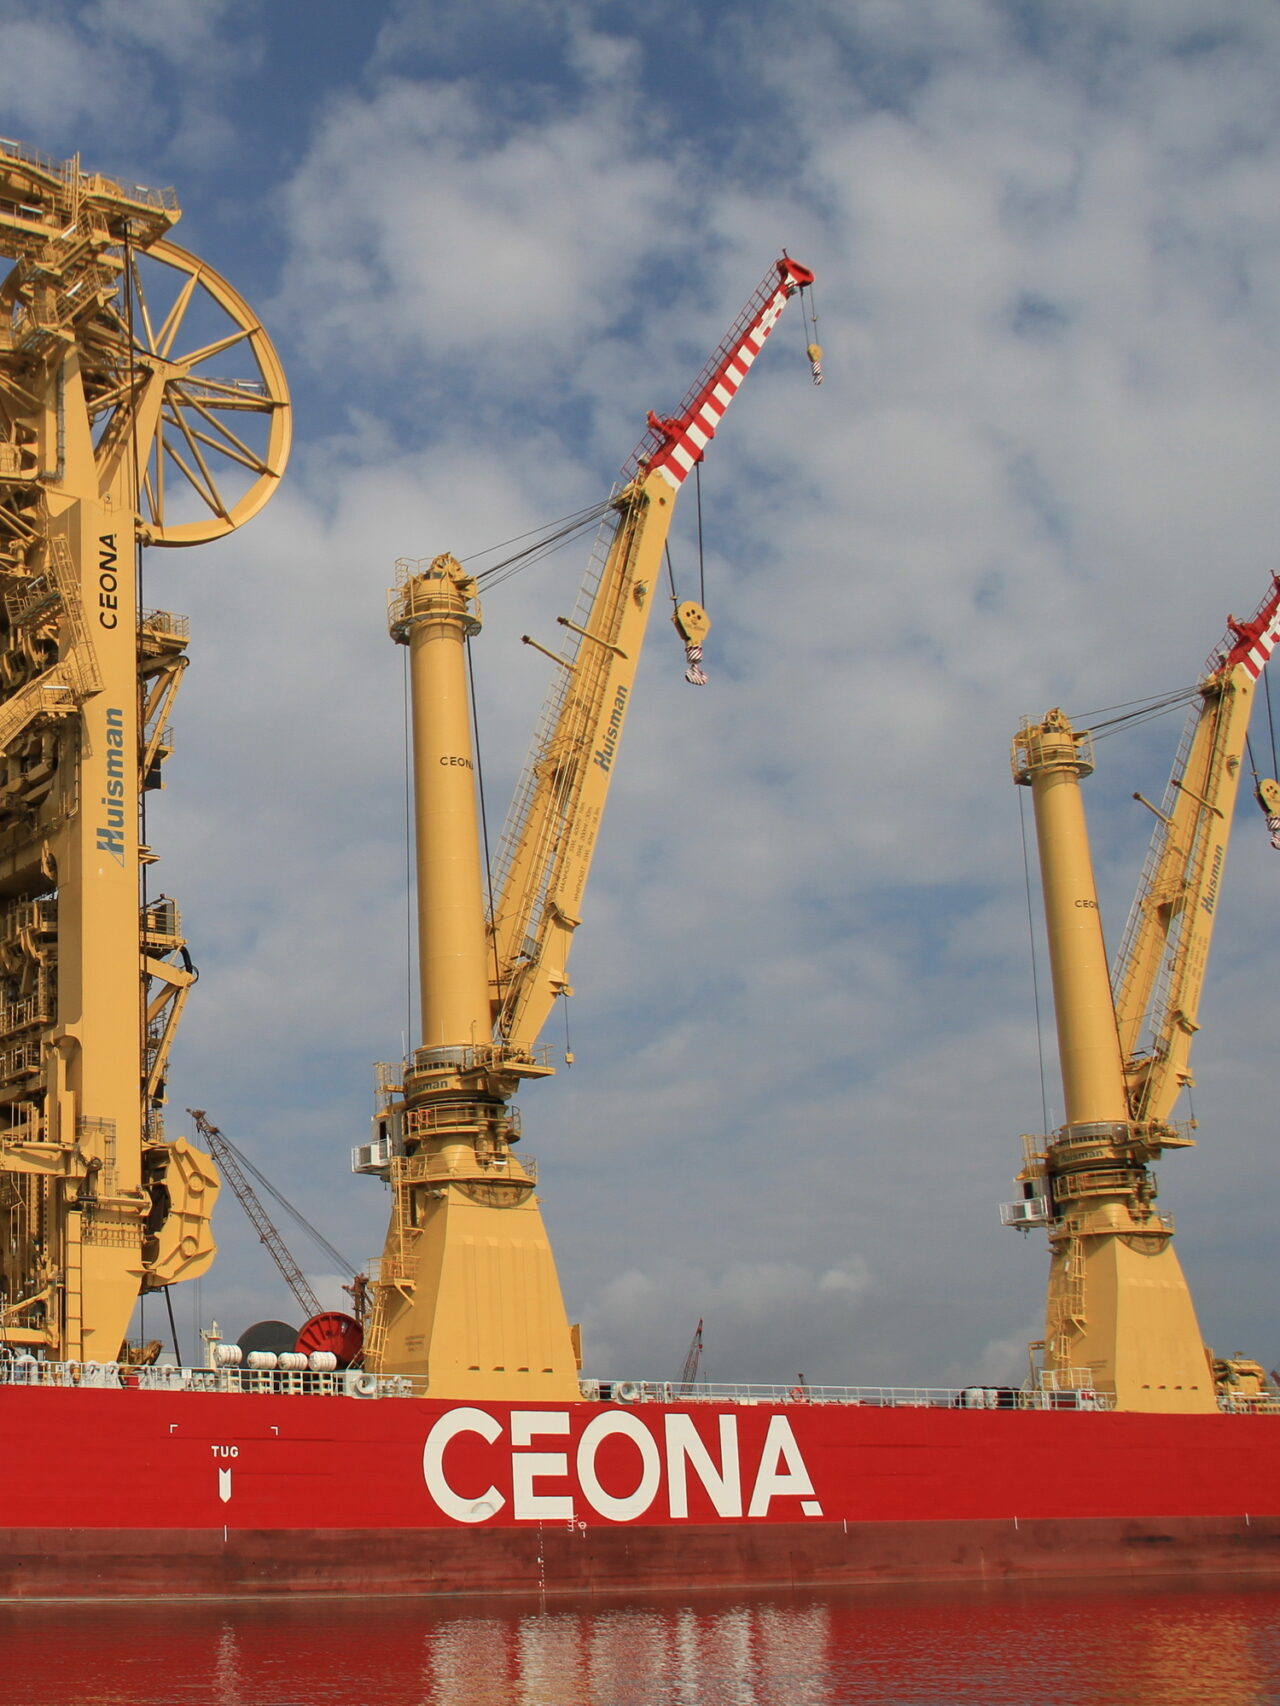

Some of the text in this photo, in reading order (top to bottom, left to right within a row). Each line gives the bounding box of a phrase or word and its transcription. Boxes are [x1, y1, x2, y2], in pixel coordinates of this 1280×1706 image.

[99, 533, 118, 630] CEONA
[593, 684, 628, 772] Huisman
[96, 707, 124, 867] Huisman
[1201, 845, 1223, 915] Huisman
[211, 1445, 239, 1458] TUG
[423, 1406, 824, 1523] CEONA
